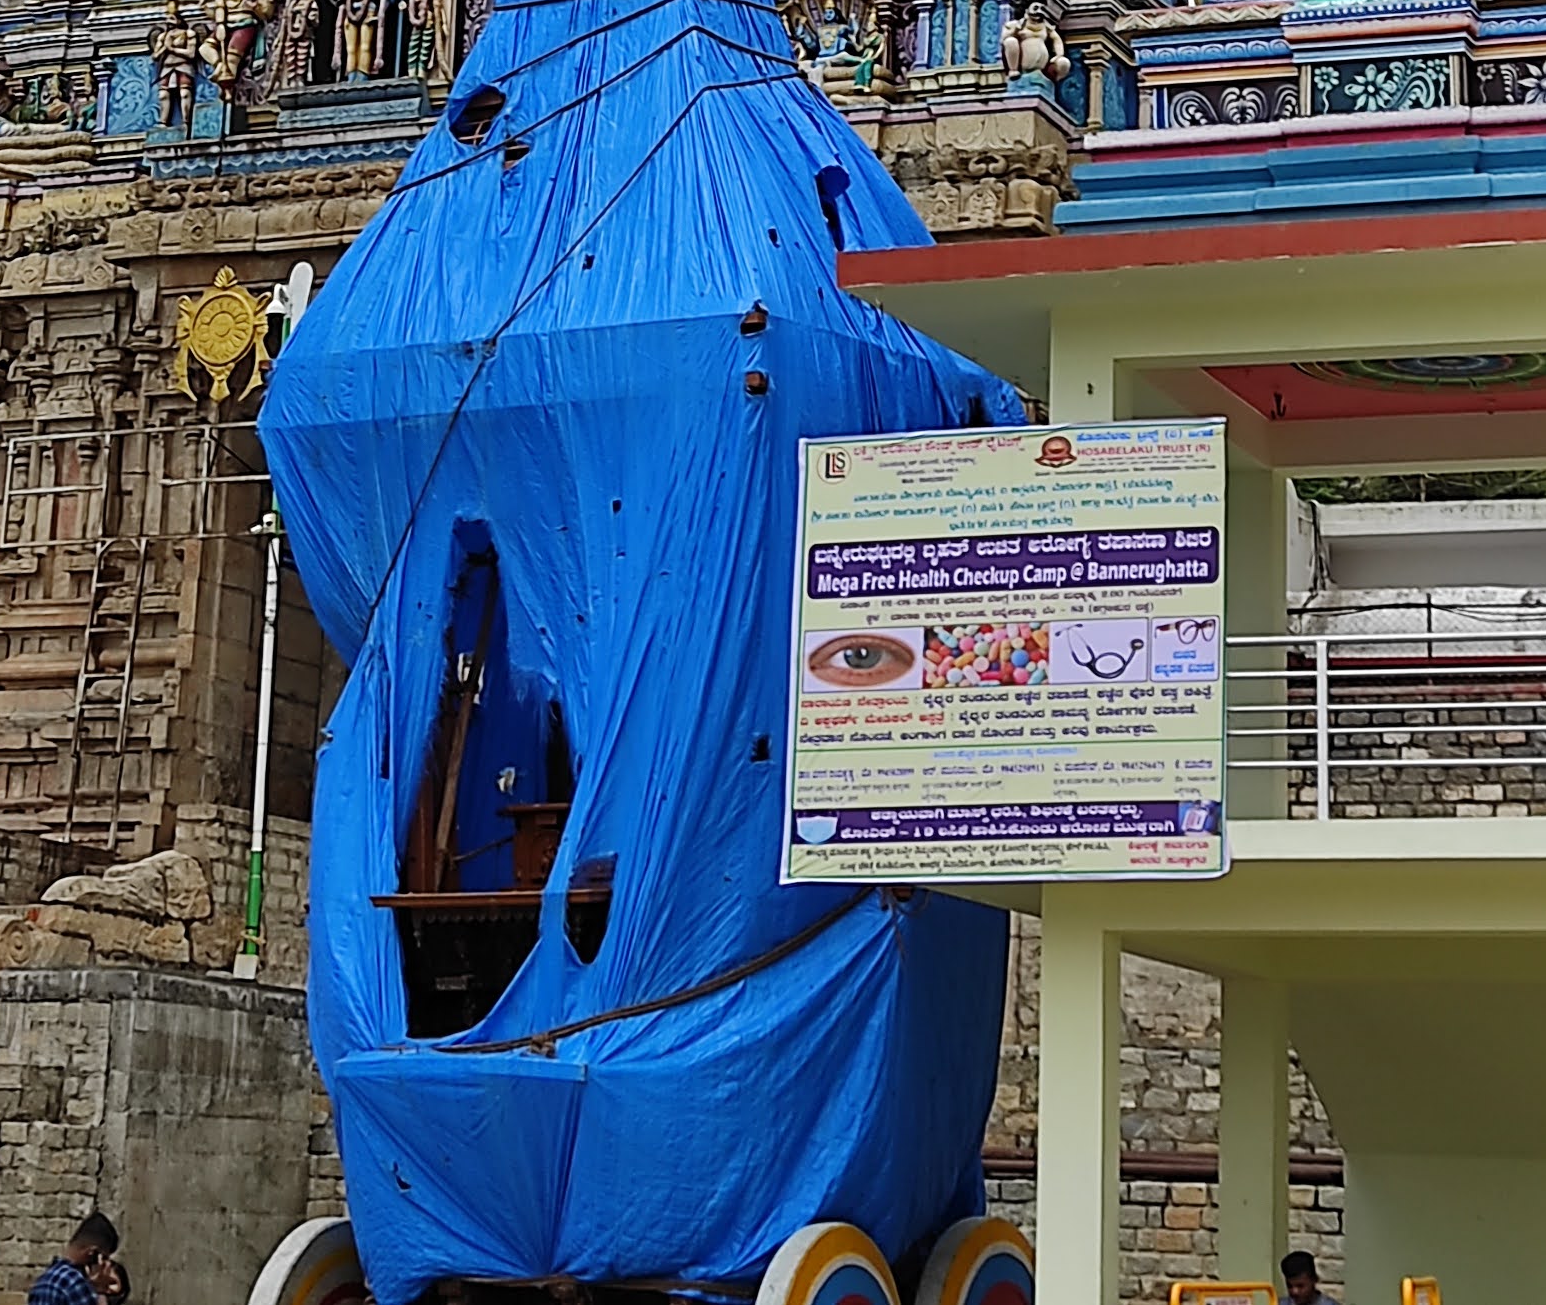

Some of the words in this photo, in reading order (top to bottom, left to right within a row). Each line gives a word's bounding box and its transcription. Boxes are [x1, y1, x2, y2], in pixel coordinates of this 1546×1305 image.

[1077, 446, 1153, 456] HOSABELAKU
[1157, 444, 1192, 453] TRUST
[1195, 443, 1211, 453] (R)
[976, 537, 1021, 556] ಉಚಿತ
[817, 574, 859, 596] Mega
[862, 572, 895, 591] Free
[898, 568, 950, 589] Health
[953, 565, 1020, 590] Checkup
[1023, 563, 1067, 587] Camp
[1070, 563, 1084, 581] @
[1087, 558, 1208, 583] Bannerughatta
